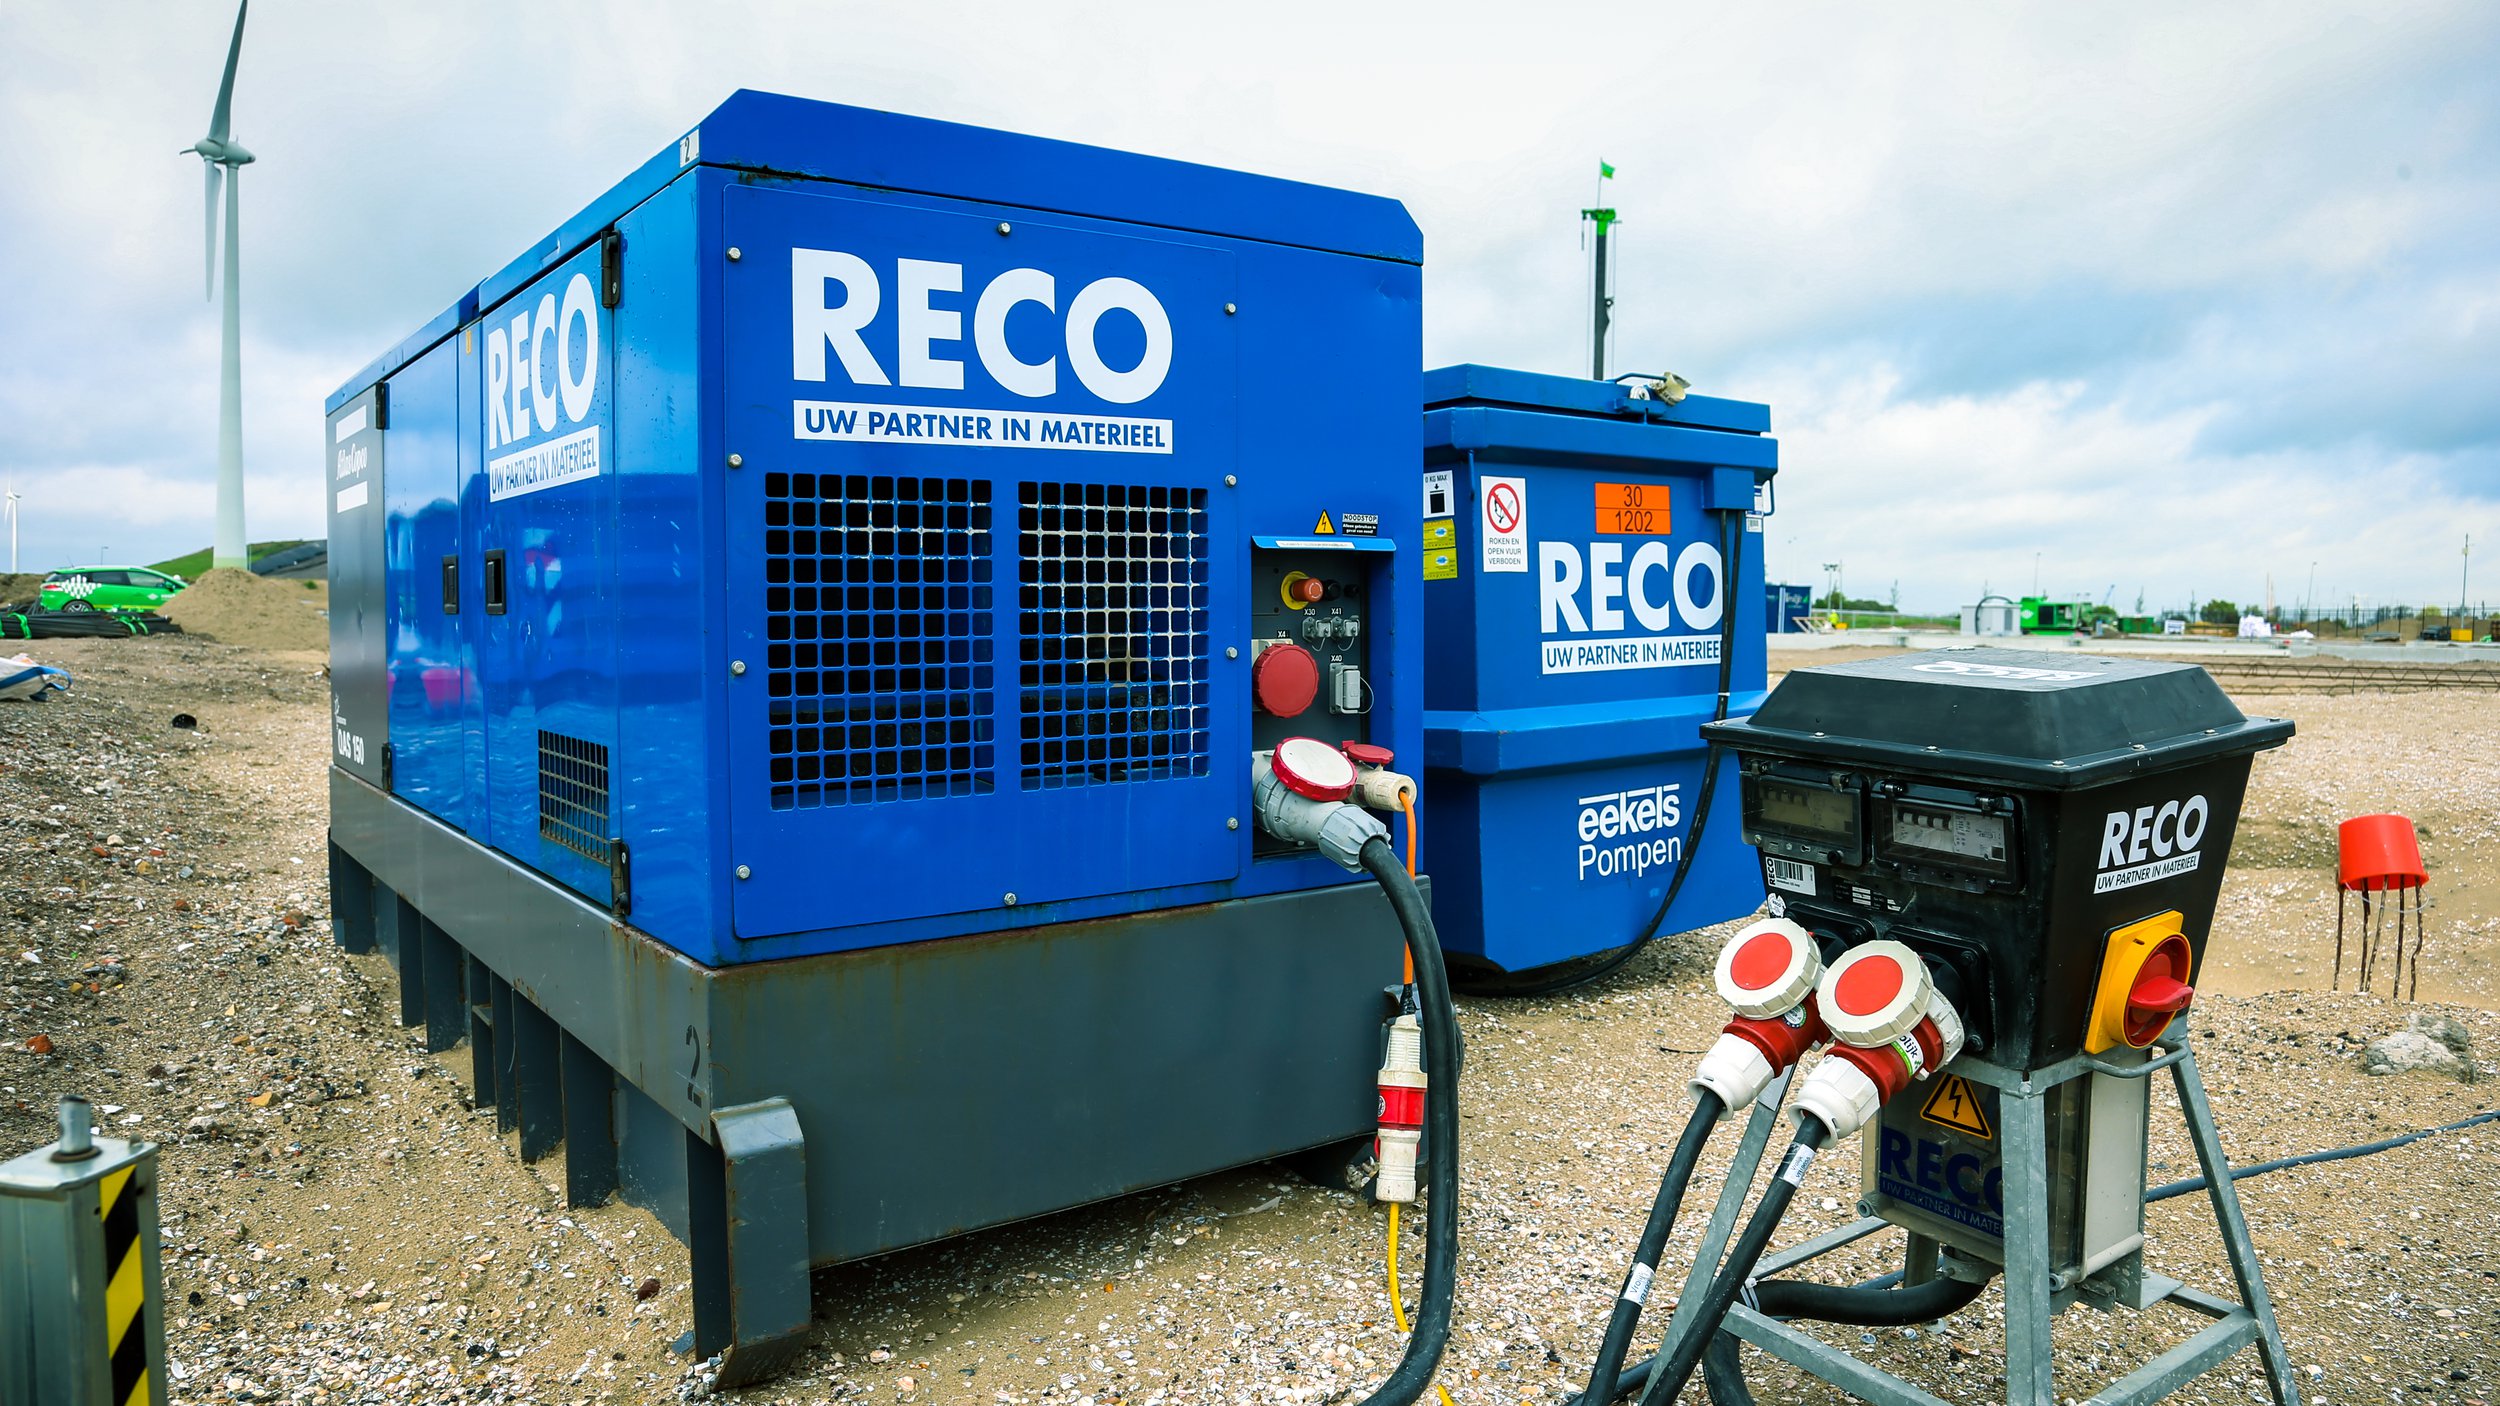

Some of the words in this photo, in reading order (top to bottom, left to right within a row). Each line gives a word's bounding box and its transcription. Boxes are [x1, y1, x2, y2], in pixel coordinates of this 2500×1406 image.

[792, 247, 1173, 404] RECO
[488, 273, 599, 450] RECO
[805, 407, 858, 434] UW
[868, 411, 993, 440] PARTNER
[1002, 418, 1031, 442] IN
[1040, 420, 1166, 448] MATERIEEL
[491, 465, 504, 494] UW
[505, 455, 538, 491] PARTNER
[540, 451, 549, 481] IN
[551, 437, 597, 479] MATERIEEL
[1623, 485, 1643, 507] 30
[1343, 514, 1377, 522] NOODSTOP
[1615, 510, 1653, 532] 1202
[1487, 547, 1504, 555] OPEN
[1505, 547, 1521, 555] VUUR
[1489, 537, 1510, 545] ROKEN
[1488, 557, 1521, 565] VERBODEN
[1538, 541, 1723, 633] RECO
[1303, 608, 1316, 616] X30
[1331, 607, 1342, 615] X41
[1330, 654, 1343, 662] X40
[1546, 647, 1573, 668] UW
[1578, 644, 1638, 666] PARTNER
[1642, 643, 1657, 663] IN
[1661, 640, 1722, 661] MATERIEE
[1578, 785, 1680, 842] eekels
[2098, 794, 2208, 870] RECO
[1579, 837, 1681, 881] Pompen
[1767, 858, 1776, 886] RECO
[2097, 875, 2115, 889] UW
[2115, 869, 2150, 886] PARTNER
[2151, 864, 2162, 878] IN
[2161, 855, 2197, 876] MATERIEEL
[1899, 1035, 1919, 1059] olijk
[685, 1024, 702, 1109] 2
[1904, 1188, 1951, 1216] PARTNER
[1953, 1207, 1967, 1221] IN
